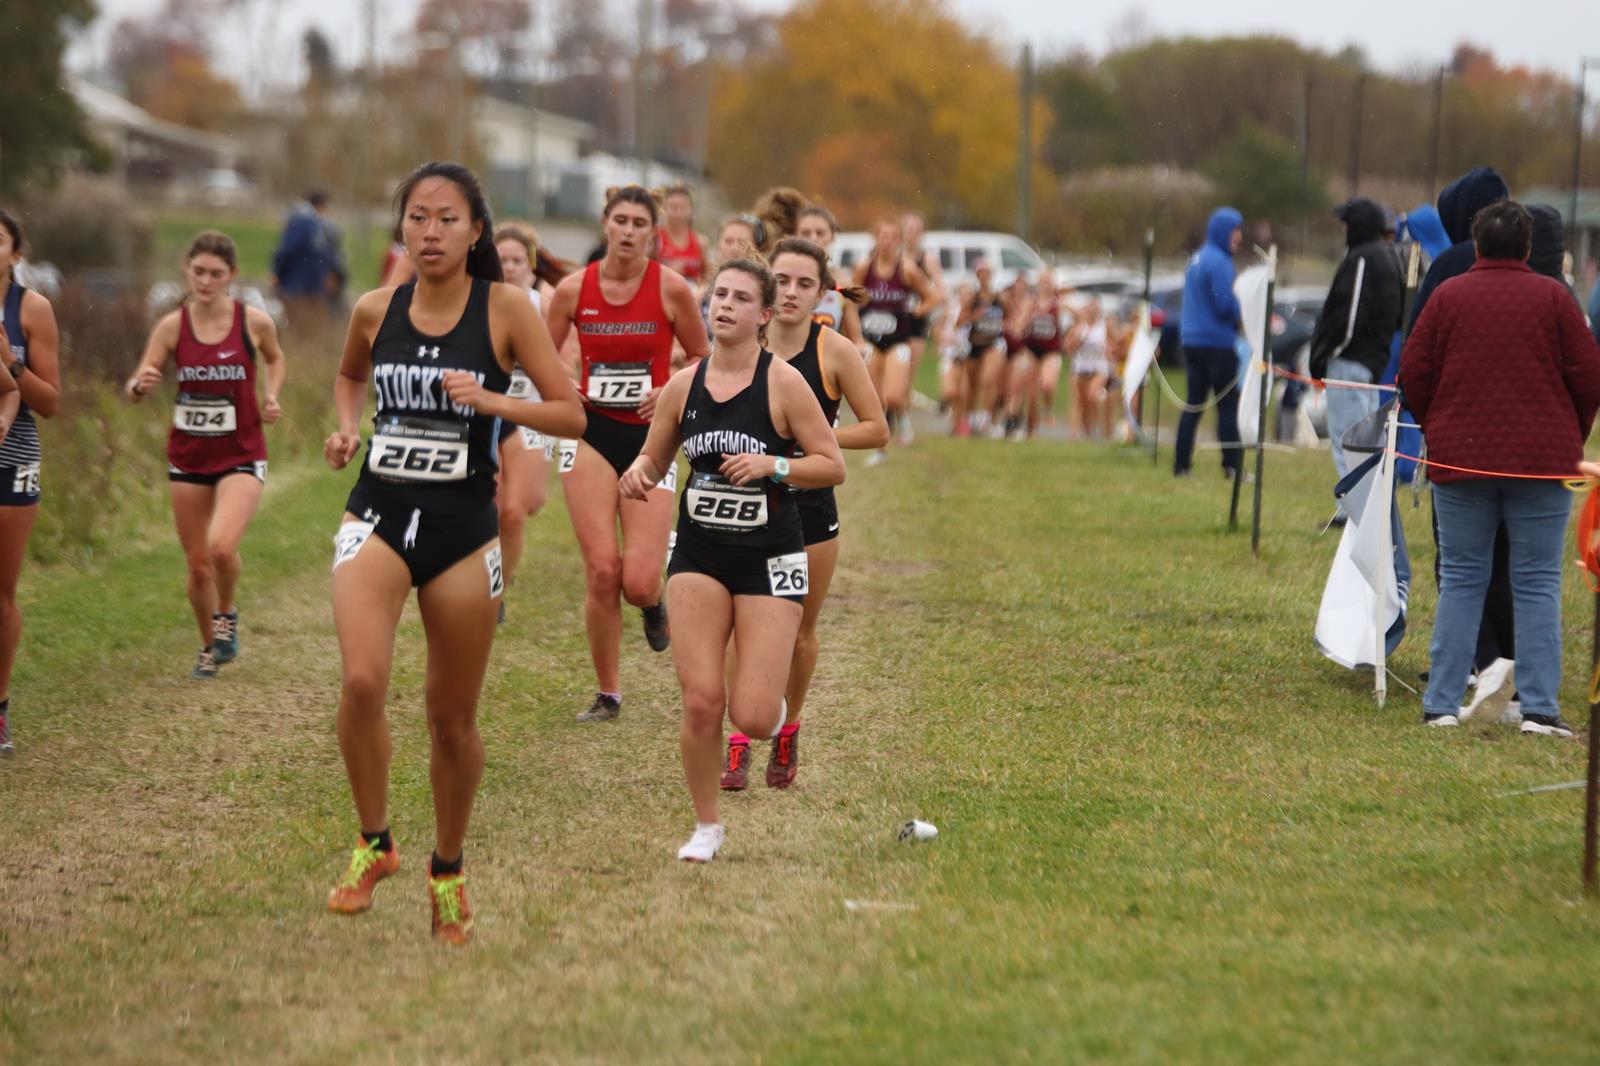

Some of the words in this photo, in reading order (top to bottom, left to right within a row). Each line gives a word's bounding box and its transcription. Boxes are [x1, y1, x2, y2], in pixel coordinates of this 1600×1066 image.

[599, 381, 643, 398] 172
[185, 410, 226, 428] 104
[378, 444, 460, 474] 262
[693, 496, 763, 522] 268
[772, 568, 808, 591] 26
